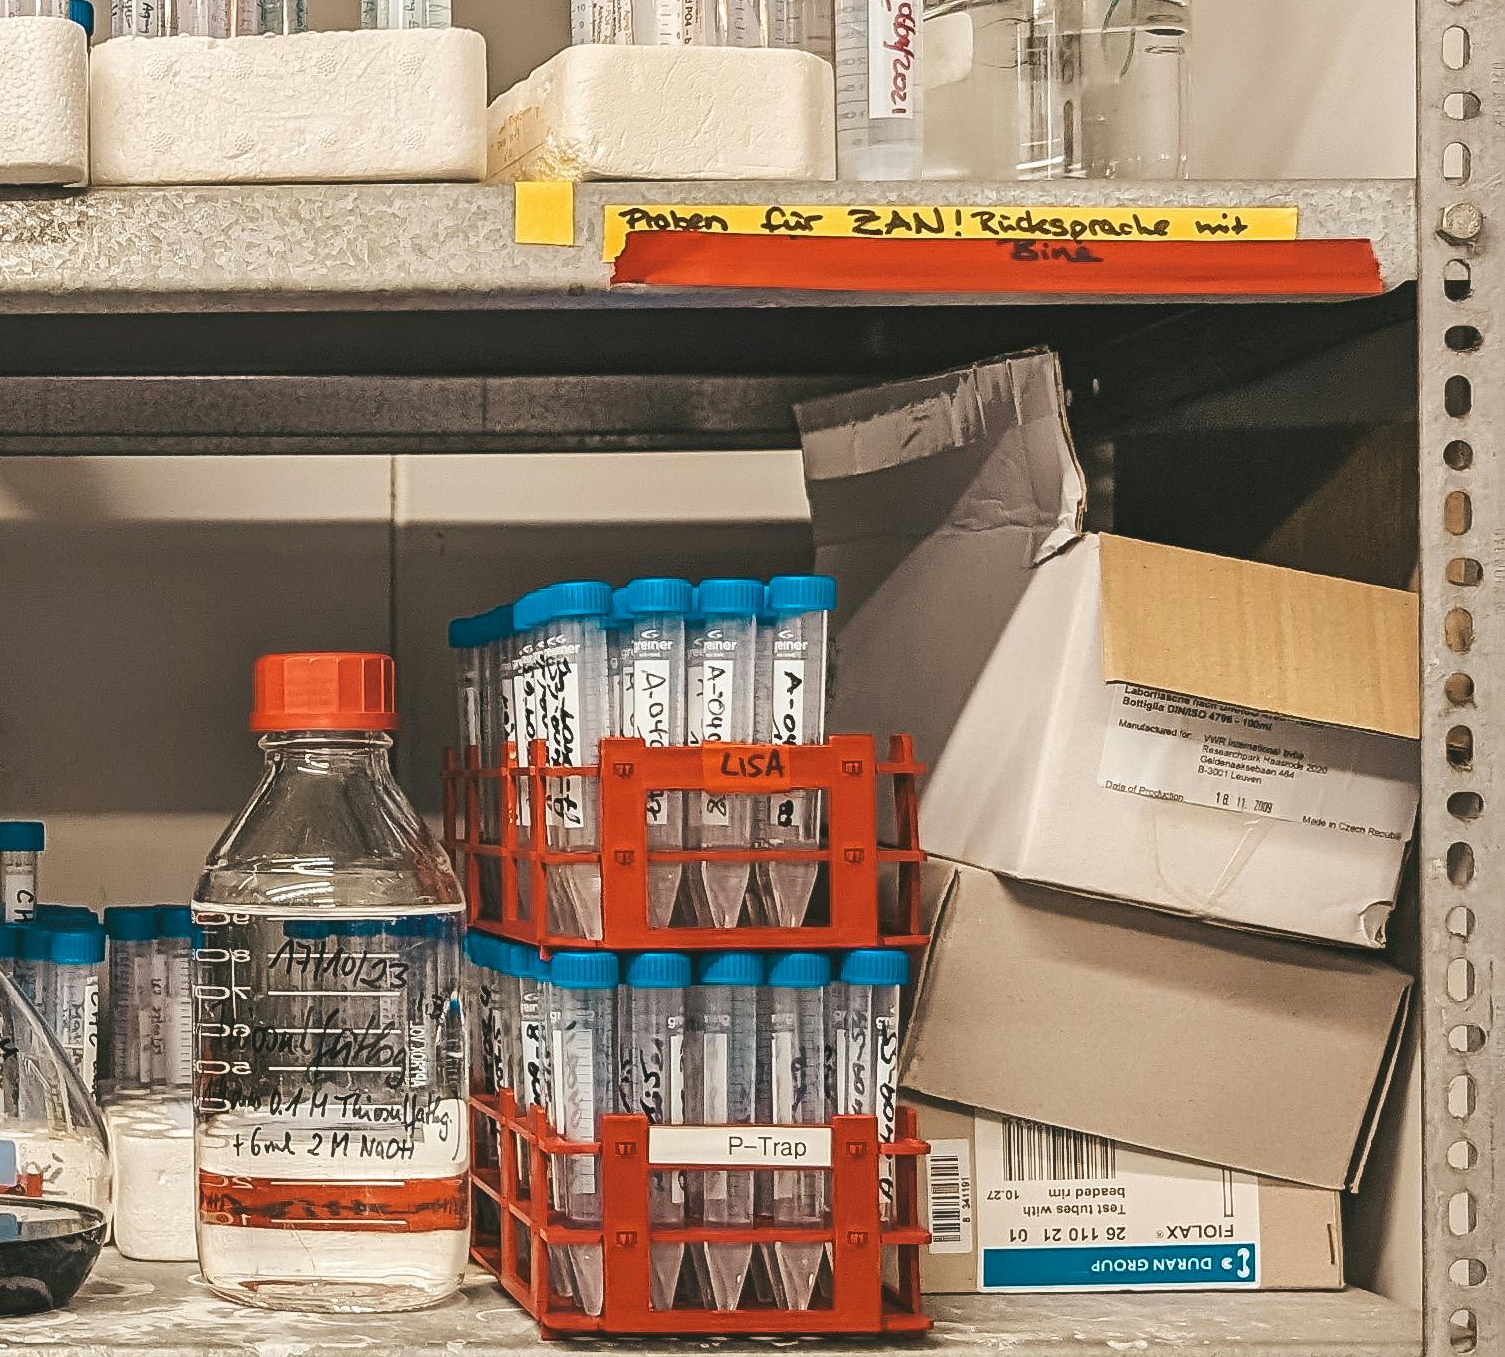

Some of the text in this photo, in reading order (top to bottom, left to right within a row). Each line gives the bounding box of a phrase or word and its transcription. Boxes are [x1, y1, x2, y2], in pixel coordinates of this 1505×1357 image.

[621, 207, 1249, 238] Proben für ZAN! Rücksprache mit
[702, 640, 738, 654] reiner
[1118, 718, 1178, 738] Manufactured
[1203, 734, 1227, 746] VWR
[720, 749, 786, 778] LISA
[1202, 745, 1262, 763] Researchpark
[1197, 765, 1263, 785] B-3001 Leuven
[1105, 779, 1127, 793] Date
[1139, 785, 1185, 803] Production
[1302, 814, 1327, 828] Made
[1338, 821, 1367, 835] Czech
[269, 939, 409, 990] 17/10/23
[308, 1091, 329, 1118] M
[306, 1132, 324, 1157] 2
[330, 1132, 349, 1158] M
[359, 1134, 416, 1161] NaOH
[727, 1135, 807, 1160] P-Trap
[962, 1175, 971, 1211] 341191
[986, 1187, 1127, 1201] beaded rim 10.27
[1023, 1203, 1127, 1217] Test tubes with
[1008, 1224, 1127, 1242] 26 110 21 01
[1091, 1256, 1213, 1273] DURAN GROUP
